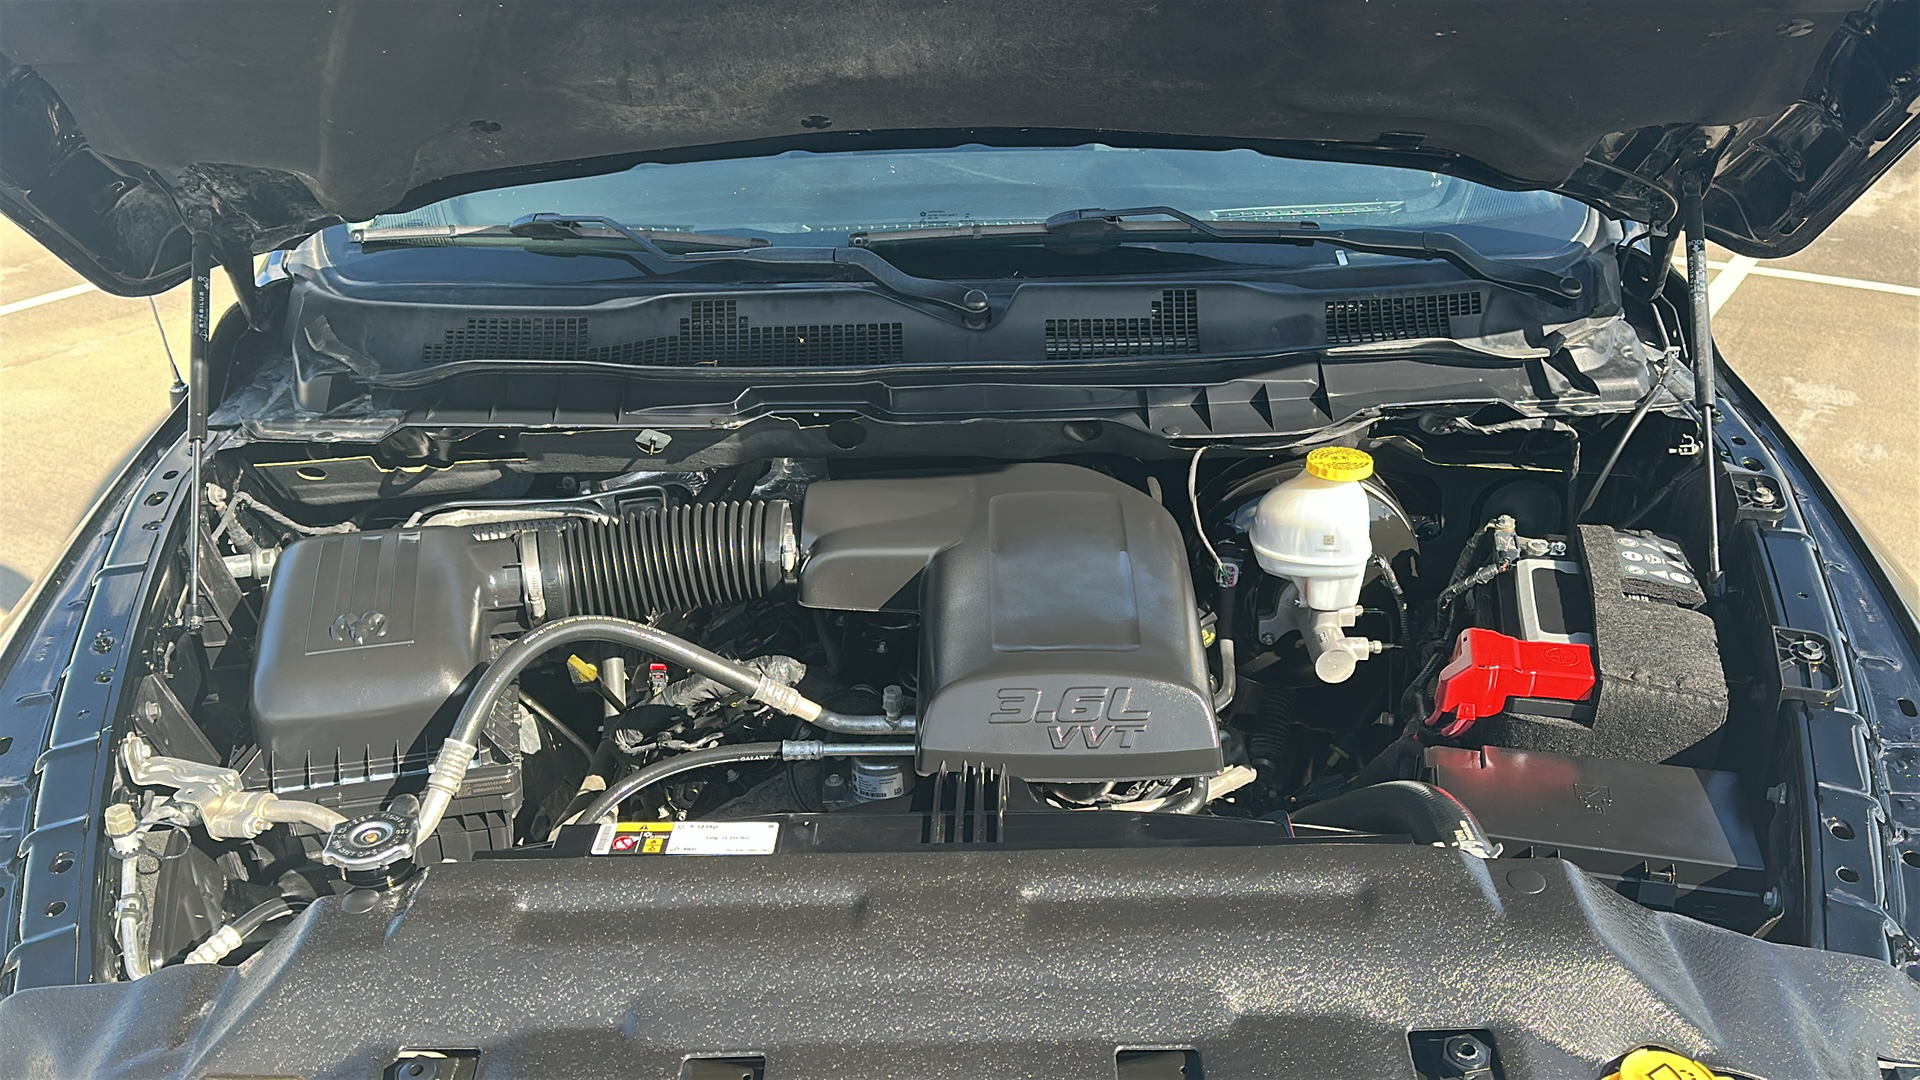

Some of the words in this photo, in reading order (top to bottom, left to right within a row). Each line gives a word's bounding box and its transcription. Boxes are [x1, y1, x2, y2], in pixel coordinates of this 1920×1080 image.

[637, 624, 667, 636] GALAXY
[989, 687, 1151, 723] 3.6L
[1047, 725, 1147, 749] VVT
